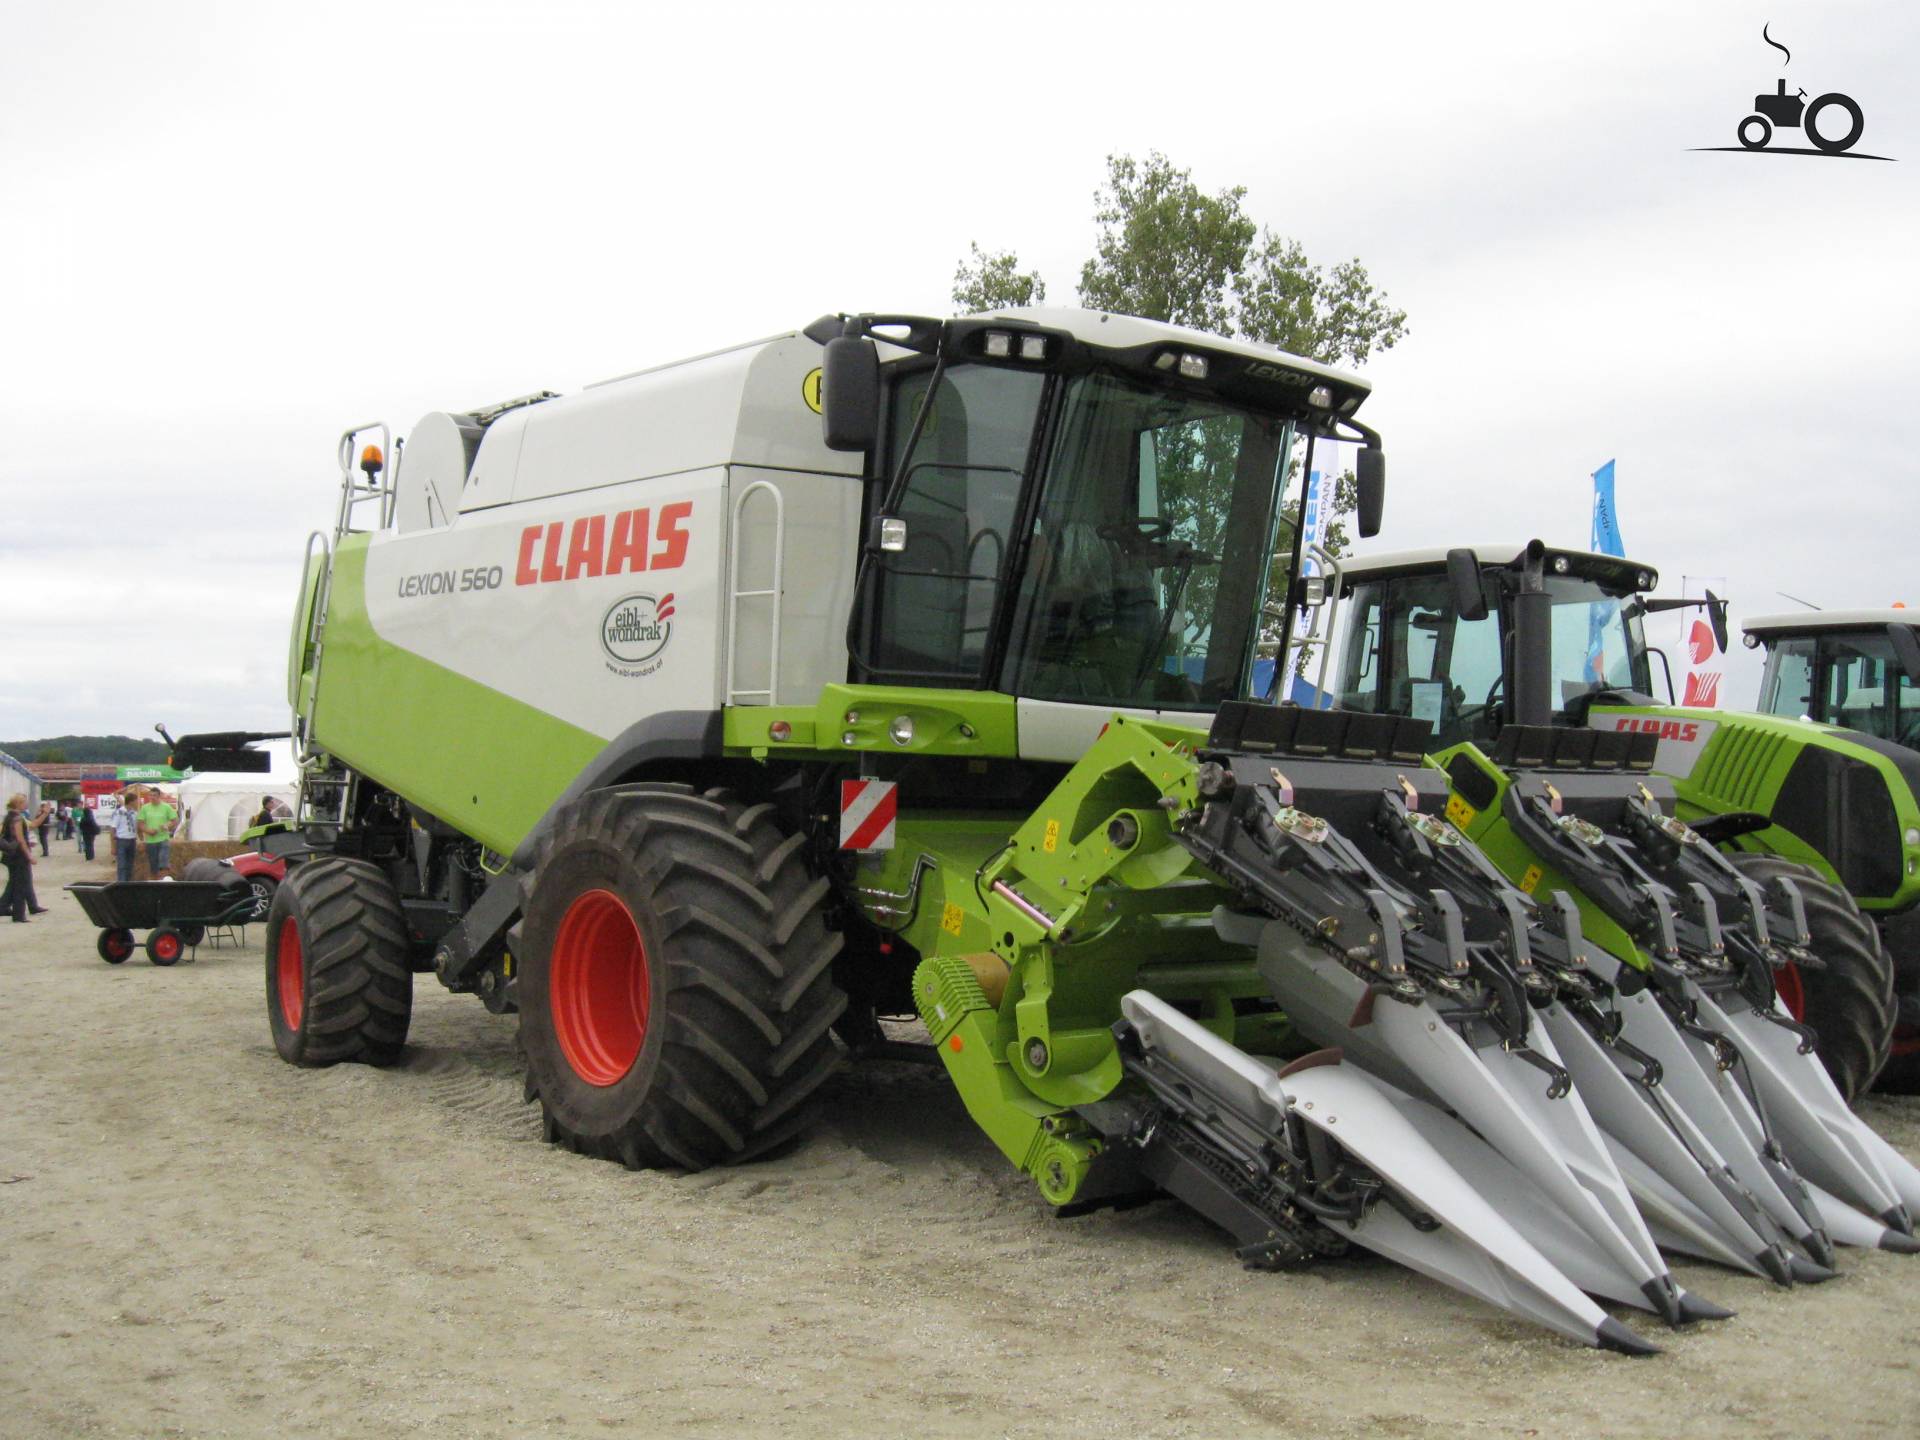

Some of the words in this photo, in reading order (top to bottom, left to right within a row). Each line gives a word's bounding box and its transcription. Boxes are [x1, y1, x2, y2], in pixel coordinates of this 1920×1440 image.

[515, 500, 693, 586] CLAAS
[398, 571, 455, 598] LEXION
[460, 565, 503, 592] 560
[608, 620, 661, 643] wondrak
